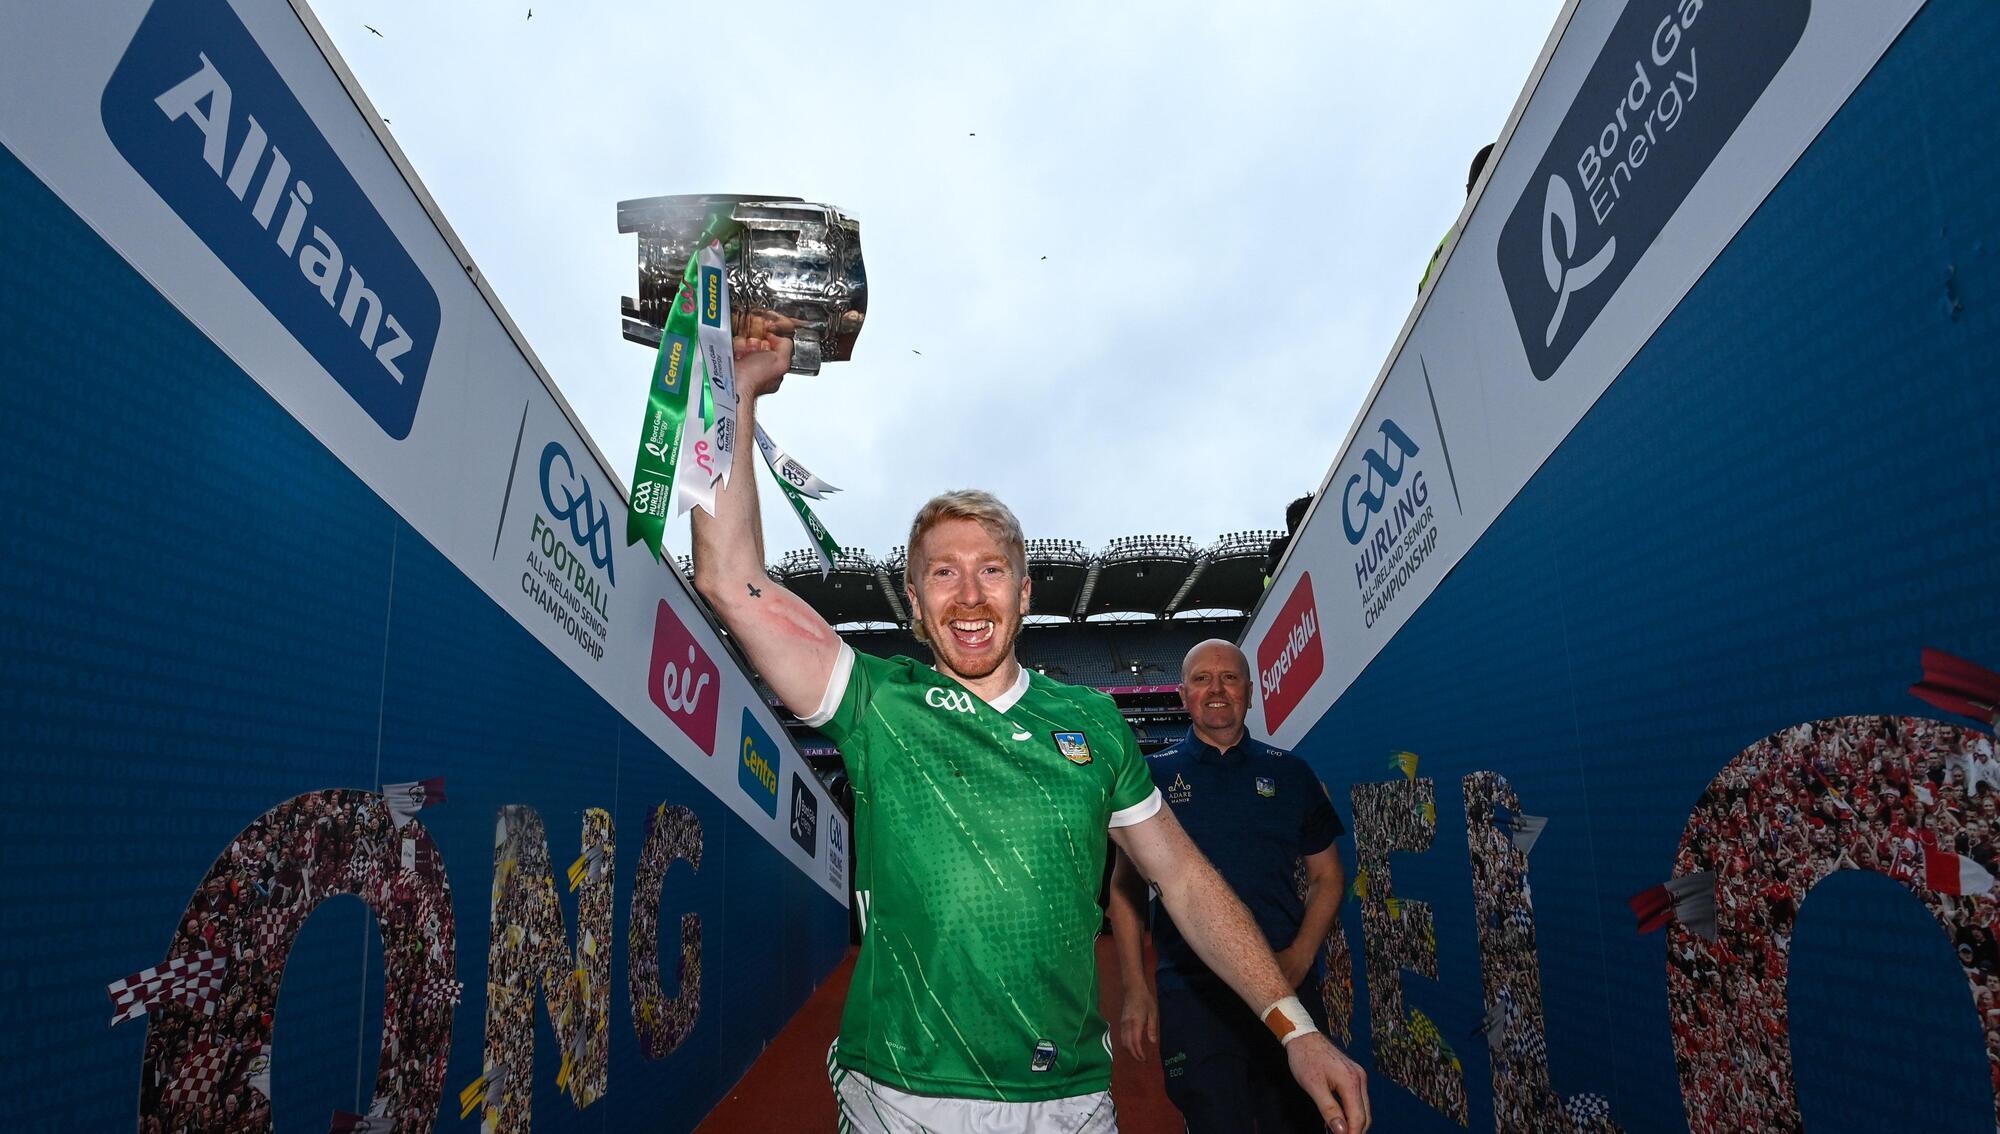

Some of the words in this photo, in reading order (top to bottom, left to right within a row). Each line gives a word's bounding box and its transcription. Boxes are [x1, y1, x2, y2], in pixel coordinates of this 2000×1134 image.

[1577, 60, 1651, 192] Bord
[1589, 47, 1698, 226] Energy
[154, 51, 415, 385] Allianz
[707, 274, 718, 320] Centra
[664, 342, 682, 386] Centra
[657, 420, 668, 444] Energy
[649, 482, 661, 516] HURLING
[1355, 470, 1429, 589] HURLING
[526, 550, 579, 614] ALL-IRELAND
[580, 606, 607, 642] SENIOR
[530, 513, 609, 623] FOOTBALL
[1362, 548, 1404, 608] ALL-IRELAND
[1403, 505, 1434, 554] SENIOR
[1365, 526, 1438, 629] CHAMPIONSHIP
[521, 572, 604, 662] CHAMPIONSHIP
[1261, 608, 1317, 701] SuperValu
[663, 644, 710, 715] eir
[743, 736, 776, 797] Centra
